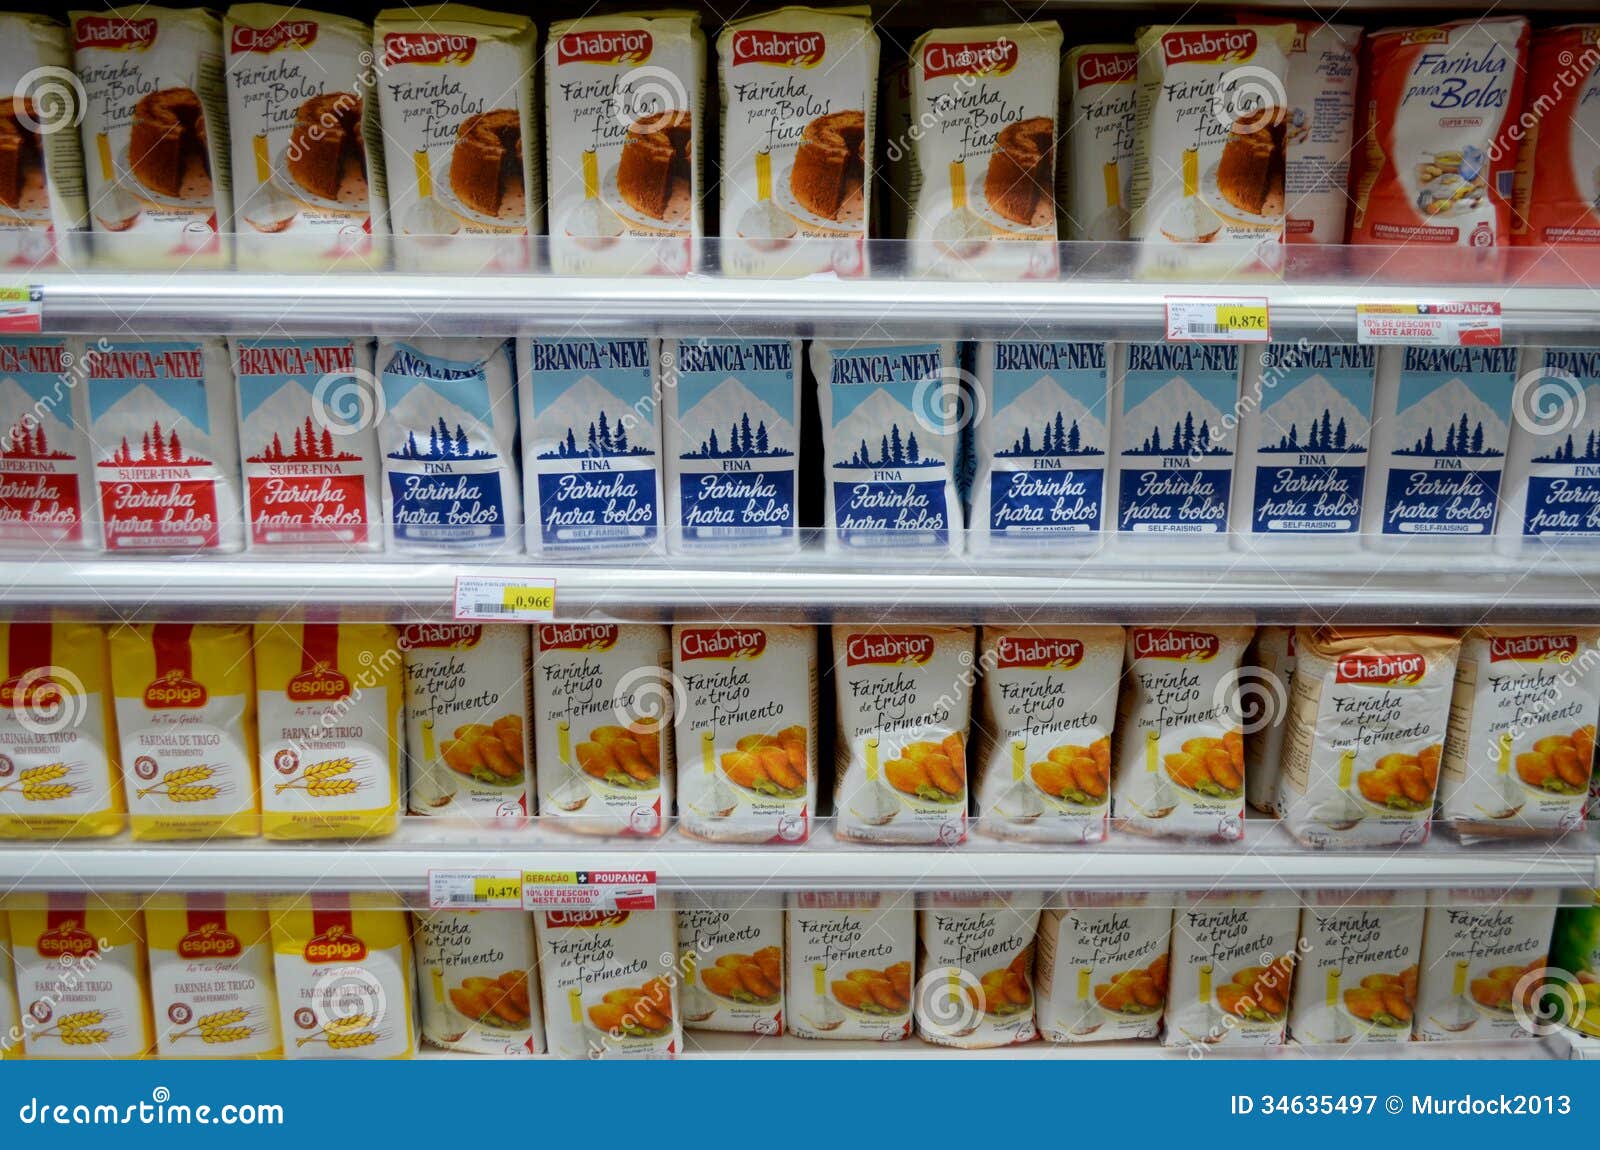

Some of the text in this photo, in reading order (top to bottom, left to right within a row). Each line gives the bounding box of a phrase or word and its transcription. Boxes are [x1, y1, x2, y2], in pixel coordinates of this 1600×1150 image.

[234, 21, 312, 49] Chabrior
[559, 34, 648, 58] Chabrior
[736, 34, 820, 59] Chabrior
[1164, 33, 1251, 58] Chabrior
[926, 42, 1012, 69] Chabrior
[1414, 42, 1507, 76] Farinha
[234, 61, 303, 88] Farinha
[560, 74, 634, 98] Farinha
[1164, 72, 1238, 101] Farinha
[109, 78, 159, 97] Bolos
[272, 81, 326, 102] Bolos
[389, 75, 462, 102] Farinha
[734, 76, 808, 102] Farinha
[928, 84, 1002, 114] Farinha
[1402, 77, 1508, 109] para Bolos
[262, 102, 300, 130] fina
[403, 94, 484, 121] para Bolos
[748, 98, 830, 127] para Bolos
[971, 103, 1023, 128] Bolos
[422, 116, 462, 145] fina
[765, 116, 805, 145] fina
[960, 126, 998, 156] fina
[1363, 320, 1441, 328] 10% DE DESCONTO
[534, 341, 649, 370] BRANCA NEVE
[753, 344, 792, 370] NEVE
[996, 342, 1106, 370] BRANCA NEVE
[1128, 344, 1238, 371] BRANCA NEVE
[270, 463, 342, 475] SUPER-FINA
[424, 463, 452, 473] FINA
[581, 460, 611, 471] FINA
[723, 460, 751, 471] FINA
[1033, 458, 1061, 469] FINA
[1162, 457, 1191, 468] FINA
[1299, 455, 1326, 465] FINA
[1434, 458, 1462, 469] FINA
[118, 467, 192, 480] SUPER-FINA
[874, 471, 902, 481] FINA
[1009, 472, 1086, 497] Farinha
[1137, 472, 1215, 497] Farinha
[1273, 468, 1349, 493] Farinha
[1405, 472, 1484, 497] Farinha
[404, 475, 482, 500] Farinha
[557, 474, 638, 500] Farinha
[699, 474, 776, 499] Farinha
[851, 484, 929, 508] Farinha
[396, 502, 498, 524] para bolos
[546, 499, 652, 531] para bolos
[687, 500, 790, 526] para bolos
[996, 497, 1097, 526] para bolos
[1124, 496, 1225, 527] para bolos
[1258, 494, 1359, 522] para bolos
[1389, 497, 1492, 523] para bolos
[1282, 521, 1336, 529] SELF-RAISING
[1414, 523, 1469, 532] SELF-RAISING
[405, 624, 478, 643] Chabrior
[541, 624, 612, 644] Chabrior
[682, 630, 762, 655] Chabrior
[1136, 630, 1214, 652] Chabrior
[849, 637, 930, 660] Chabrior
[1000, 640, 1078, 662] Chabrior
[684, 666, 750, 691] Farinha
[1339, 656, 1421, 679] Chabrior
[147, 686, 201, 704] espiga
[291, 680, 345, 696] espiga
[563, 677, 603, 703] trigo
[849, 672, 916, 697] Farinha
[999, 676, 1065, 699] Farinha
[695, 687, 750, 713] de trigo
[860, 693, 916, 718] de trigo
[1022, 697, 1065, 722] trigo
[1156, 689, 1199, 714] trigo
[1333, 690, 1402, 712] Farinha
[321, 727, 333, 738] DE
[335, 726, 363, 738] TRIGO
[690, 701, 784, 740] sem fermento
[855, 727, 872, 737] sem
[1016, 713, 1098, 750] fermento
[48, 732, 77, 744] TRIGO
[139, 734, 220, 746] FARINHA DE TRIGO
[1349, 723, 1430, 759] fermento
[172, 748, 204, 757] FERMENTO
[526, 873, 649, 884] GERAÇÃO POUPANÇA
[526, 889, 599, 897] 10% DE DESCONTO
[799, 915, 862, 933] Farinha
[935, 912, 996, 932] Farinha
[1186, 909, 1249, 928] Farinha
[40, 937, 93, 953] espiga
[182, 938, 234, 954] espiga
[308, 943, 361, 959] espiga
[549, 933, 613, 955] Farinha
[950, 935, 1023, 976] fermento
[1203, 934, 1273, 974] fermento
[817, 943, 892, 971] fermento
[1330, 944, 1409, 977] fermento
[69, 981, 80, 992] DE
[82, 981, 113, 992] TRIGO
[174, 979, 255, 994] FARINHA DE TRIGO
[570, 959, 648, 998] fermento
